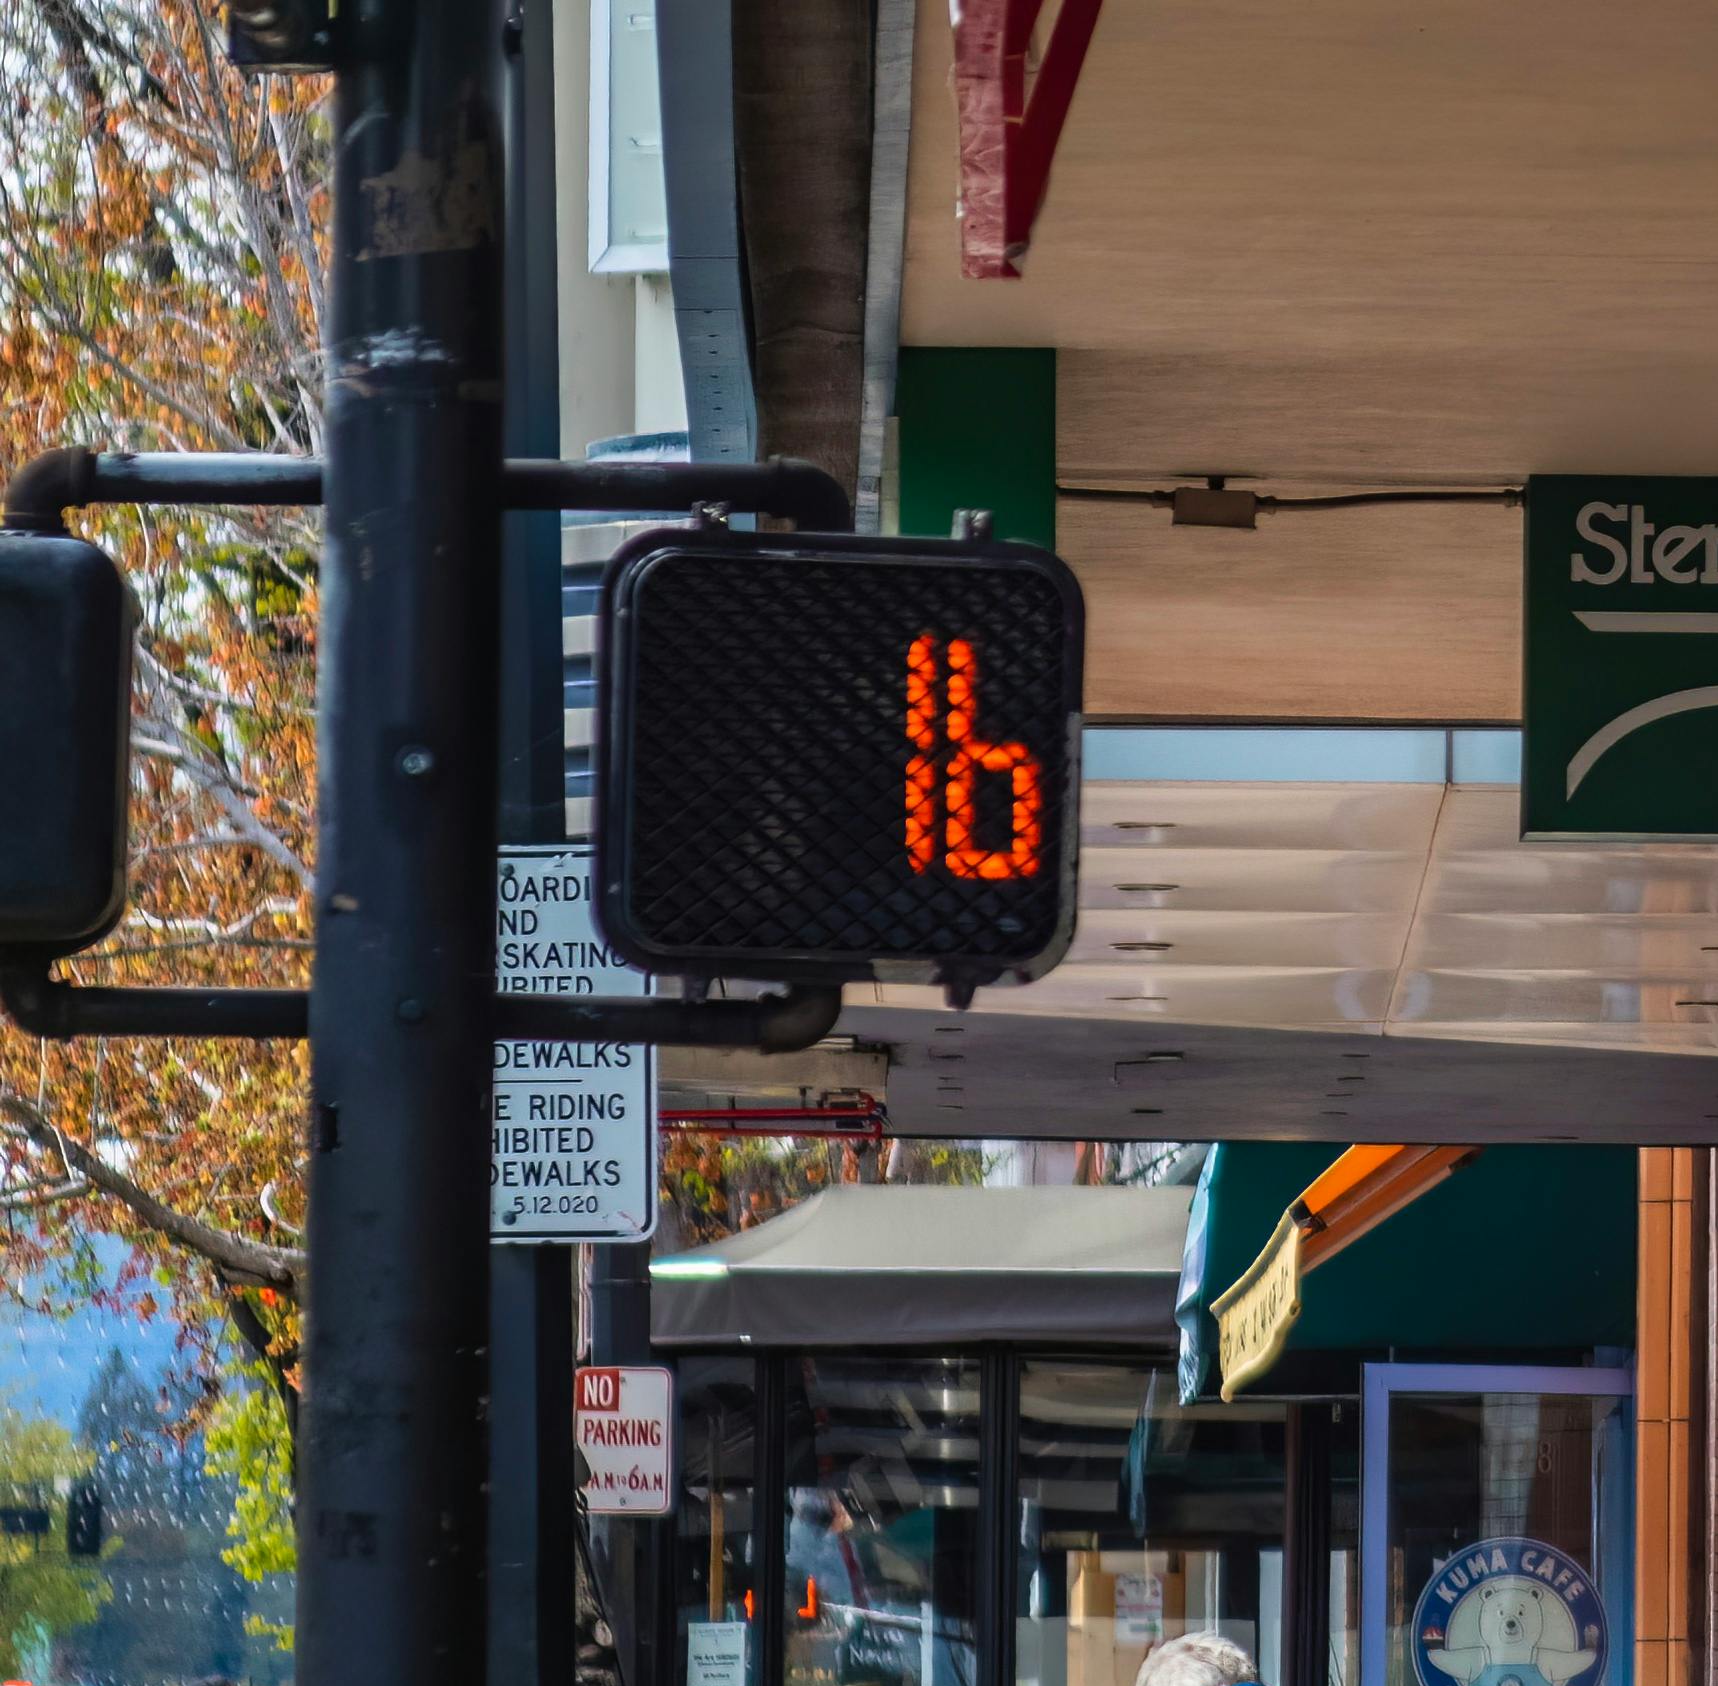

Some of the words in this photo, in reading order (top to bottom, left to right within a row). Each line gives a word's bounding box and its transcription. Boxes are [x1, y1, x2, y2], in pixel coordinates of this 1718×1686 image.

[905, 632, 1041, 880] 16
[500, 876, 590, 902] OARDI
[498, 909, 538, 936] ND
[502, 975, 594, 994] IBITED
[493, 1042, 632, 1069] DEWALKS
[494, 1094, 512, 1121] E
[528, 1093, 626, 1121] RIDING
[490, 1127, 595, 1154] HIBITED
[490, 1159, 621, 1187] DEWALKS
[583, 1374, 614, 1407] NO
[583, 1418, 662, 1446] PARKING
[1435, 1548, 1510, 1605] KUMA
[1520, 1550, 1586, 1601] CAFE
